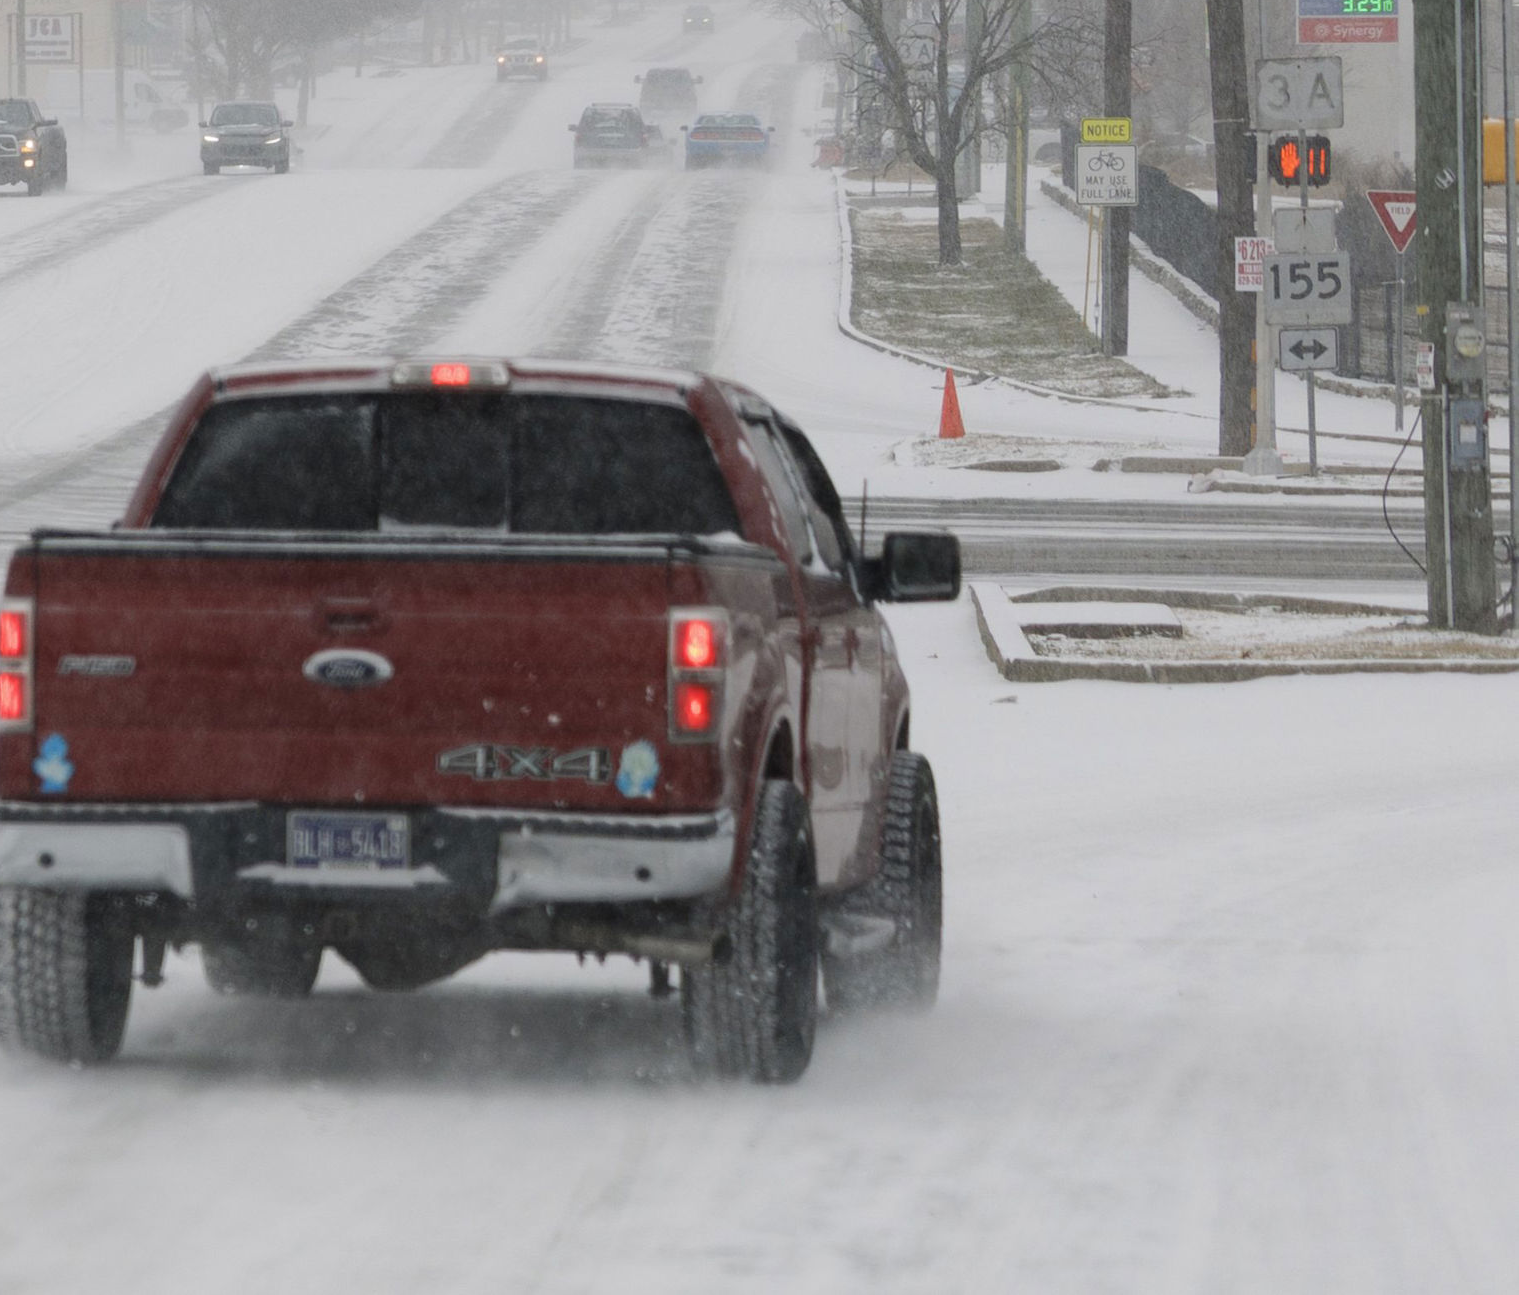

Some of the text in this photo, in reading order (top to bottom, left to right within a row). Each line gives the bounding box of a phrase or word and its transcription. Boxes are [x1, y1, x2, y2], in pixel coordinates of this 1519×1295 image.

[29, 18, 63, 38] JCA
[1333, 25, 1384, 40] Synergy
[1087, 125, 1126, 137] NOTICE
[1085, 176, 1128, 186] MAY USE
[1081, 188, 1132, 199] FULL LANE
[1269, 260, 1343, 300] 155
